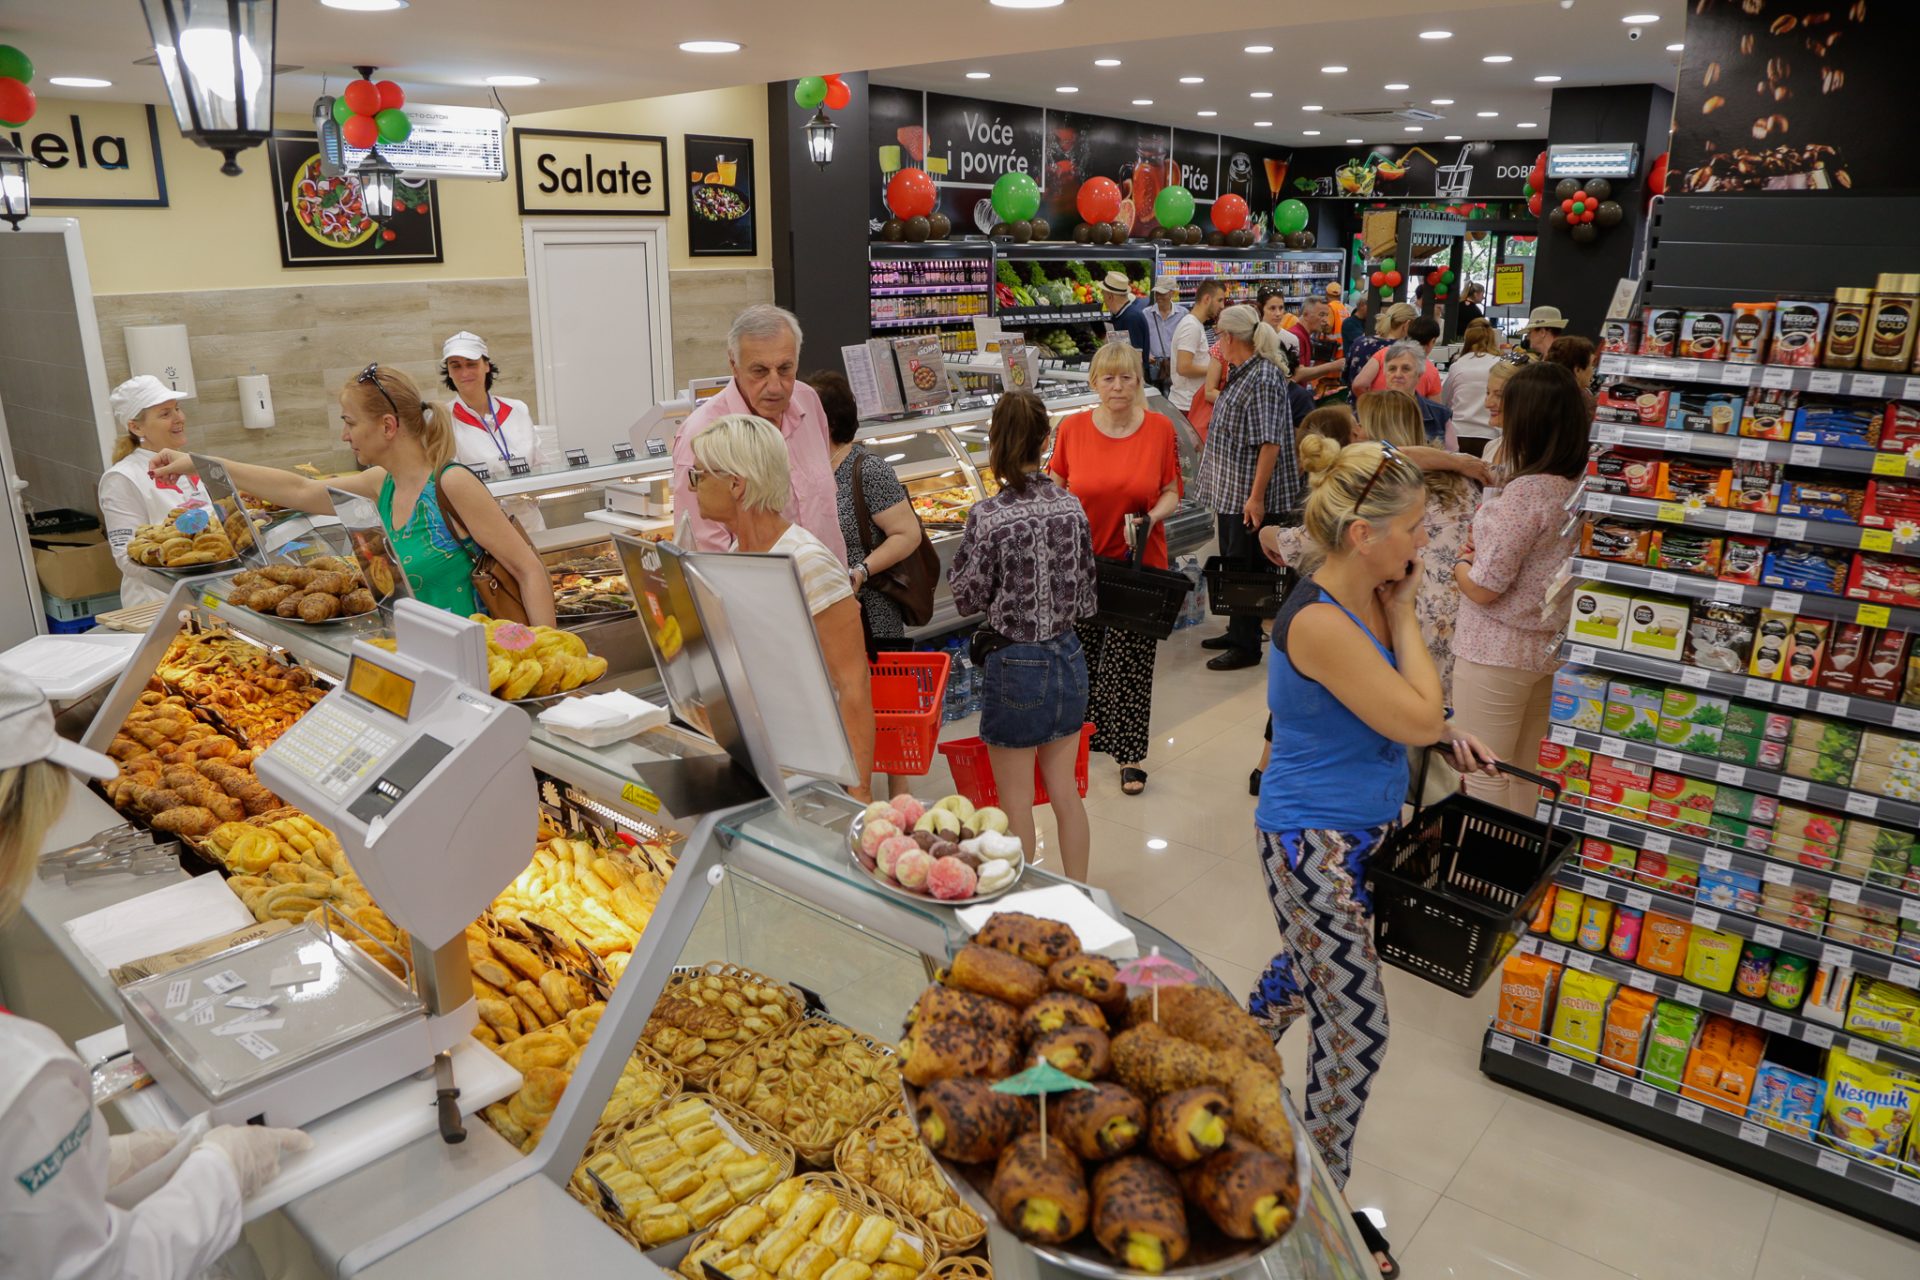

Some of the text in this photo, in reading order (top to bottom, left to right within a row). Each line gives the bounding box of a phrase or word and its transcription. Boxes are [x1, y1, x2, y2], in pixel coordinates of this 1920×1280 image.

[963, 111, 1014, 147] Voće
[537, 153, 652, 195] Salate
[947, 141, 1028, 180] i povrće
[1181, 164, 1208, 191] Piće
[1879, 321, 1905, 329] GOLD
[641, 551, 662, 572] AROM
[1834, 1080, 1909, 1111] Nesquik
